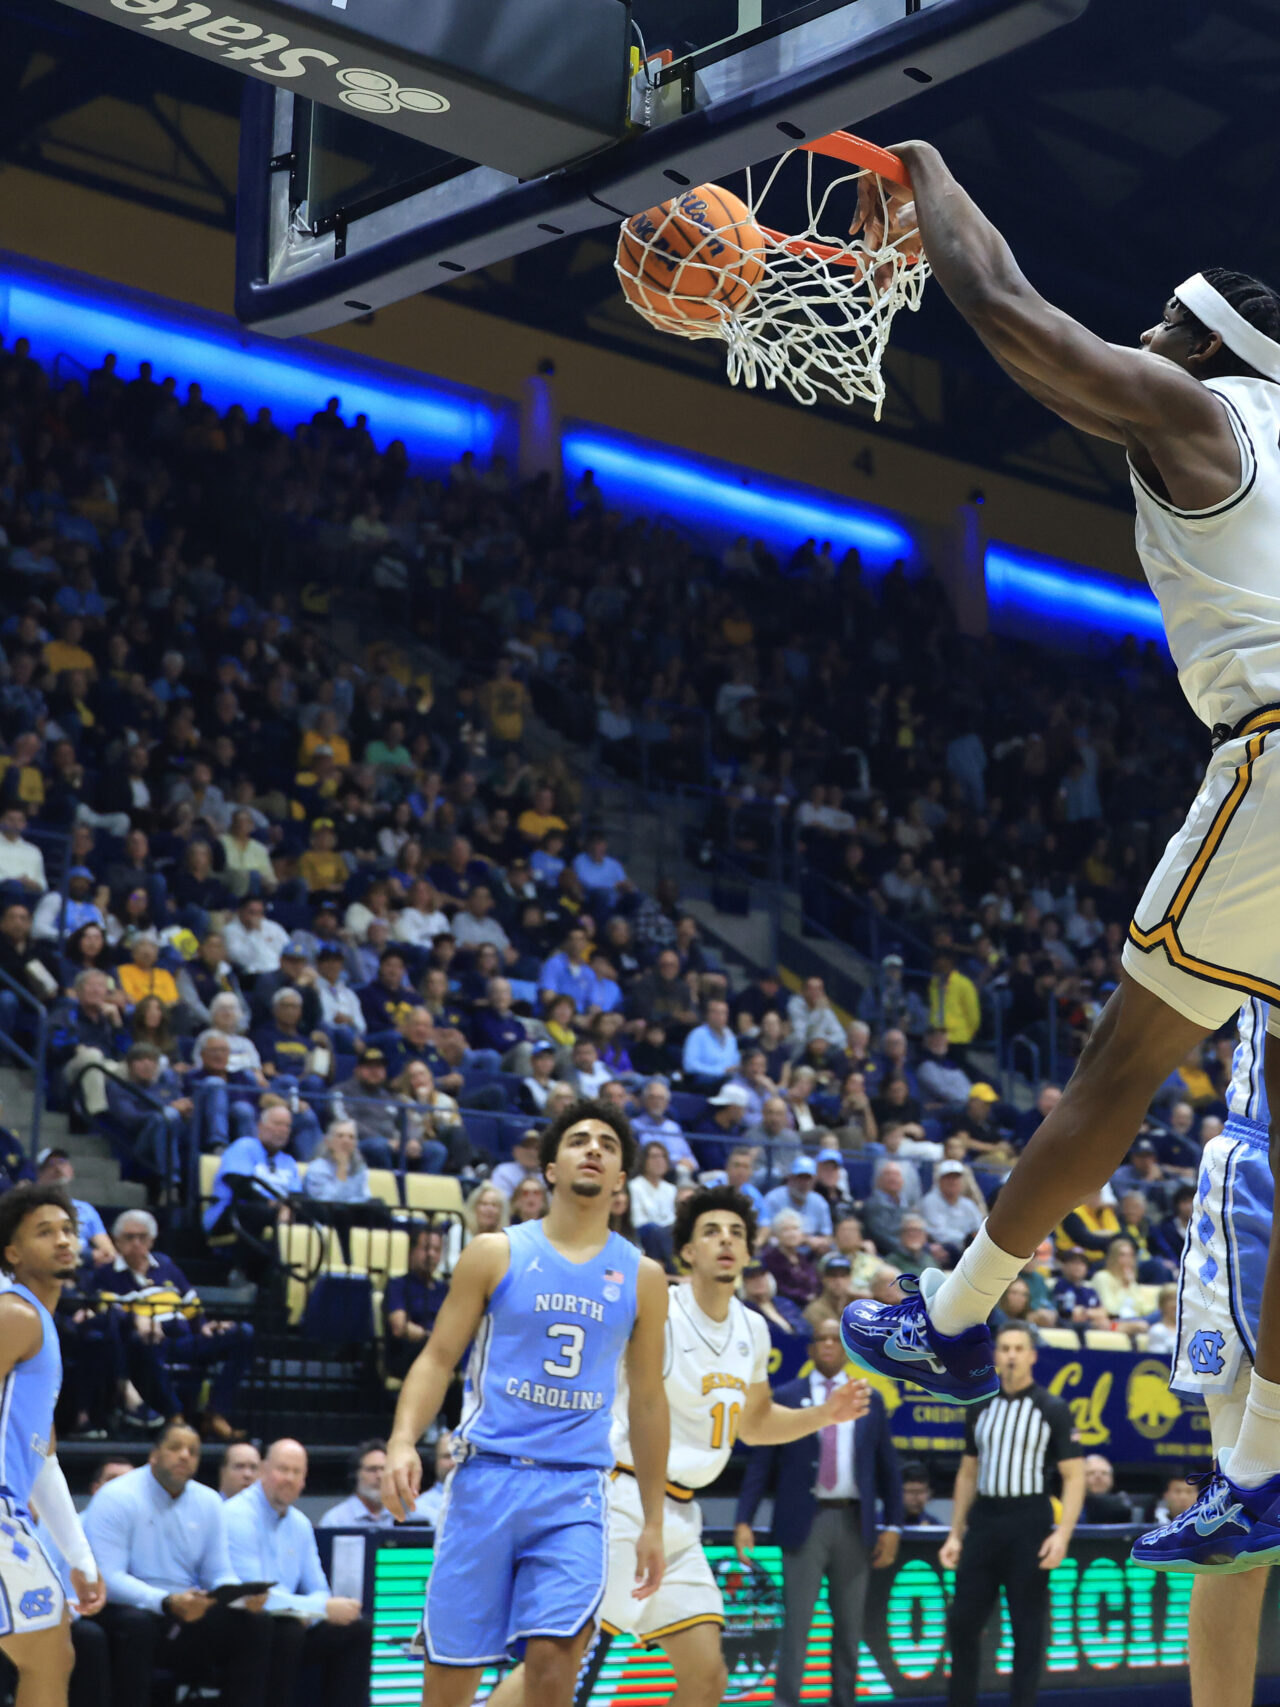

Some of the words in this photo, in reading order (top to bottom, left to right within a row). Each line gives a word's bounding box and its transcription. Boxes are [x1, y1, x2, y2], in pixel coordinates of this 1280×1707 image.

[679, 190, 726, 258] ilson
[534, 1292, 605, 1322] NORTH
[543, 1322, 586, 1379] 3
[505, 1376, 604, 1411] CAROLINA
